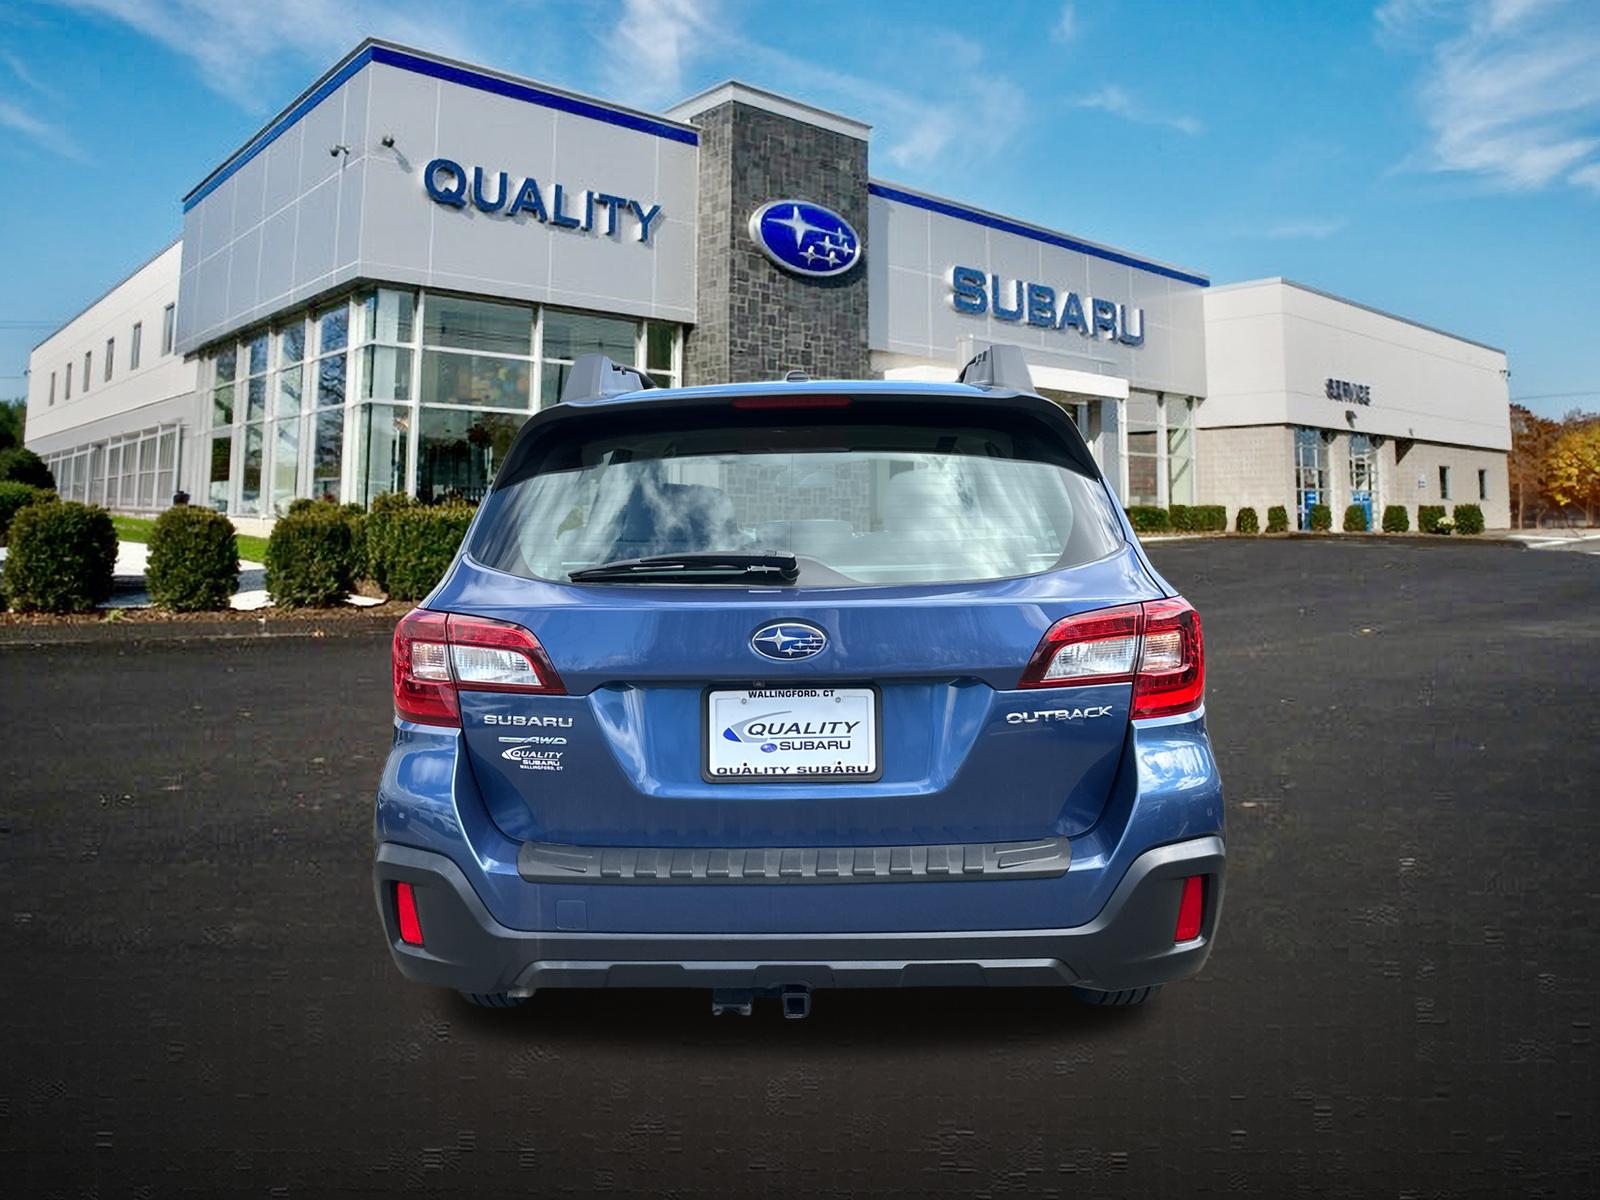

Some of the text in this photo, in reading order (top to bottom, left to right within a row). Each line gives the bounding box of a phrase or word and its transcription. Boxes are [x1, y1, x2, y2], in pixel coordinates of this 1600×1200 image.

[424, 158, 661, 243] QUALITY
[949, 265, 1144, 347] SUBARU
[1326, 378, 1371, 406] SERVICE
[823, 690, 835, 698] CT
[484, 714, 573, 728] SUBARU
[1006, 705, 1112, 724] OUTBACK
[748, 721, 861, 736] QUALITY
[779, 740, 851, 751] SUBARU
[512, 750, 563, 759] QUALITY
[716, 765, 869, 775] QUALITY SUBARU
